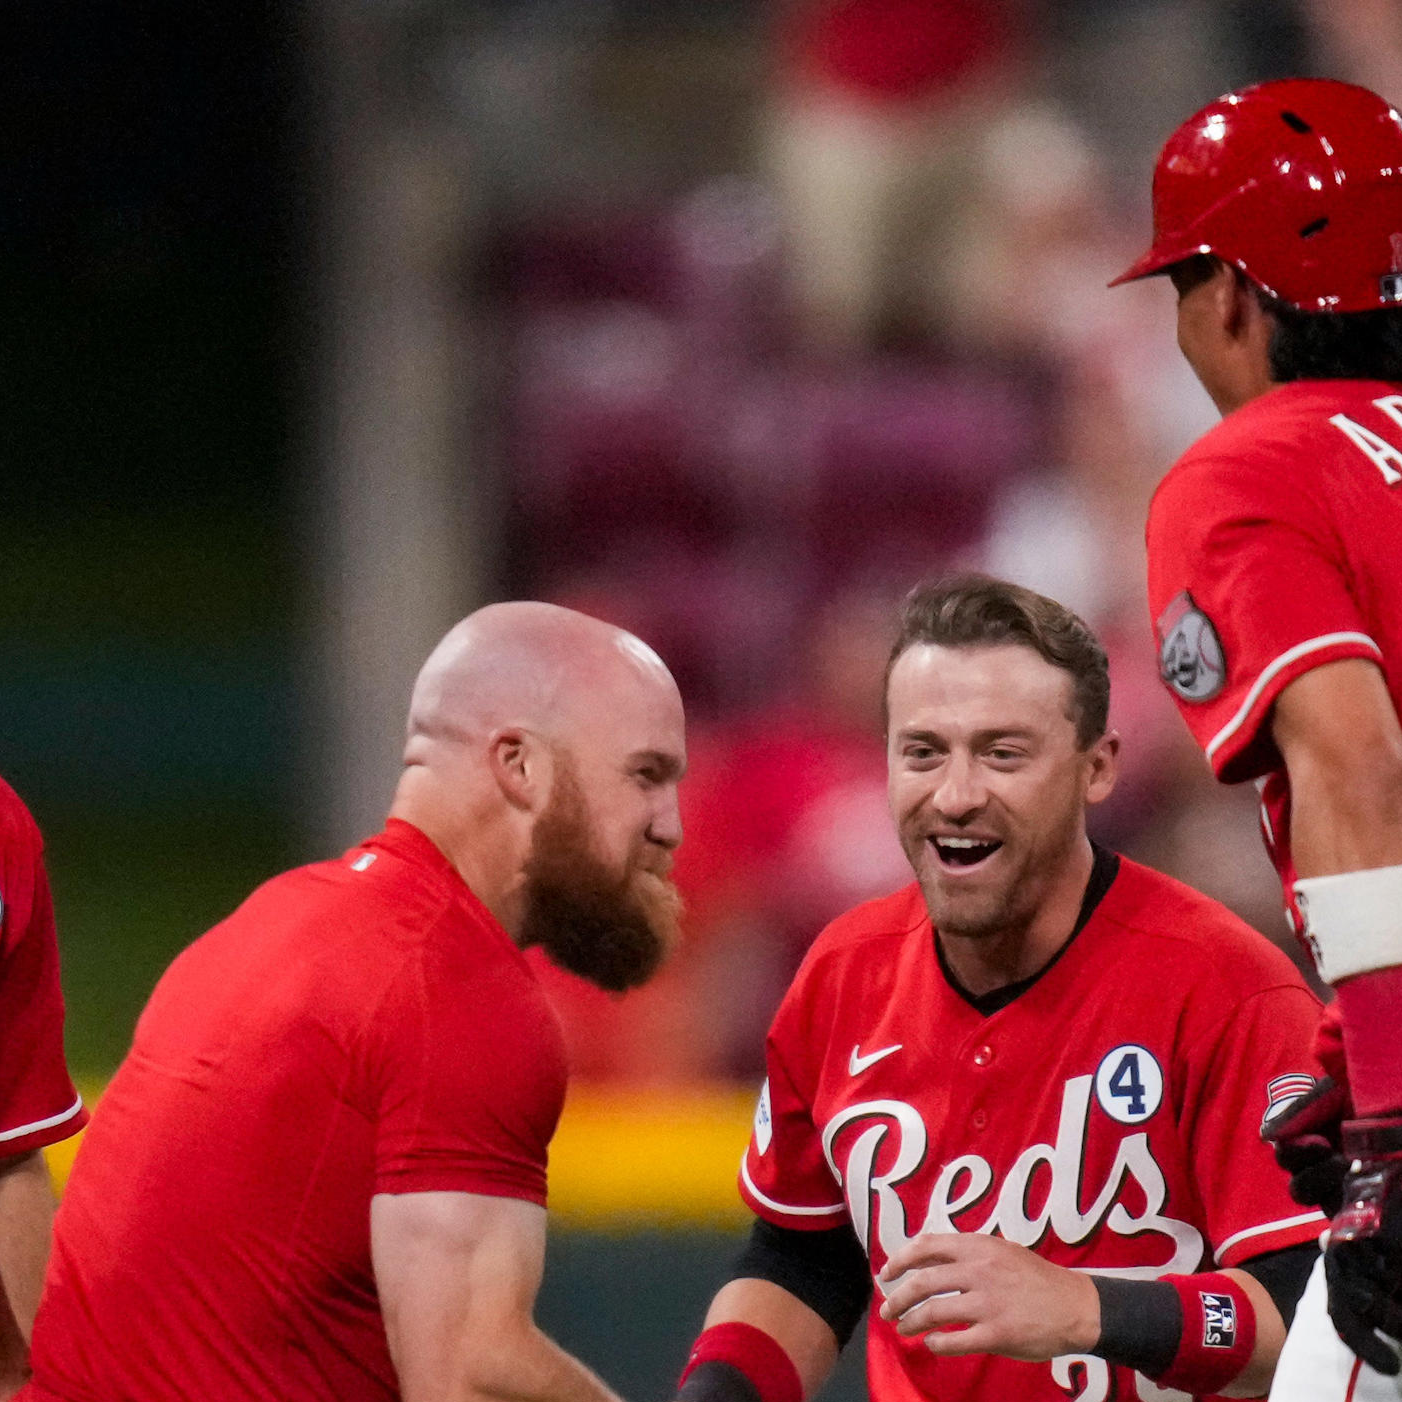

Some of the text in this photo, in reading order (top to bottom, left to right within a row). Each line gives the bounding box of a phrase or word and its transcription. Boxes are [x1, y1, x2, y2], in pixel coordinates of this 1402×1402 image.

[1108, 1053, 1146, 1115] 4
[822, 1074, 1203, 1278] Reds
[1205, 1308, 1223, 1344] ALS
